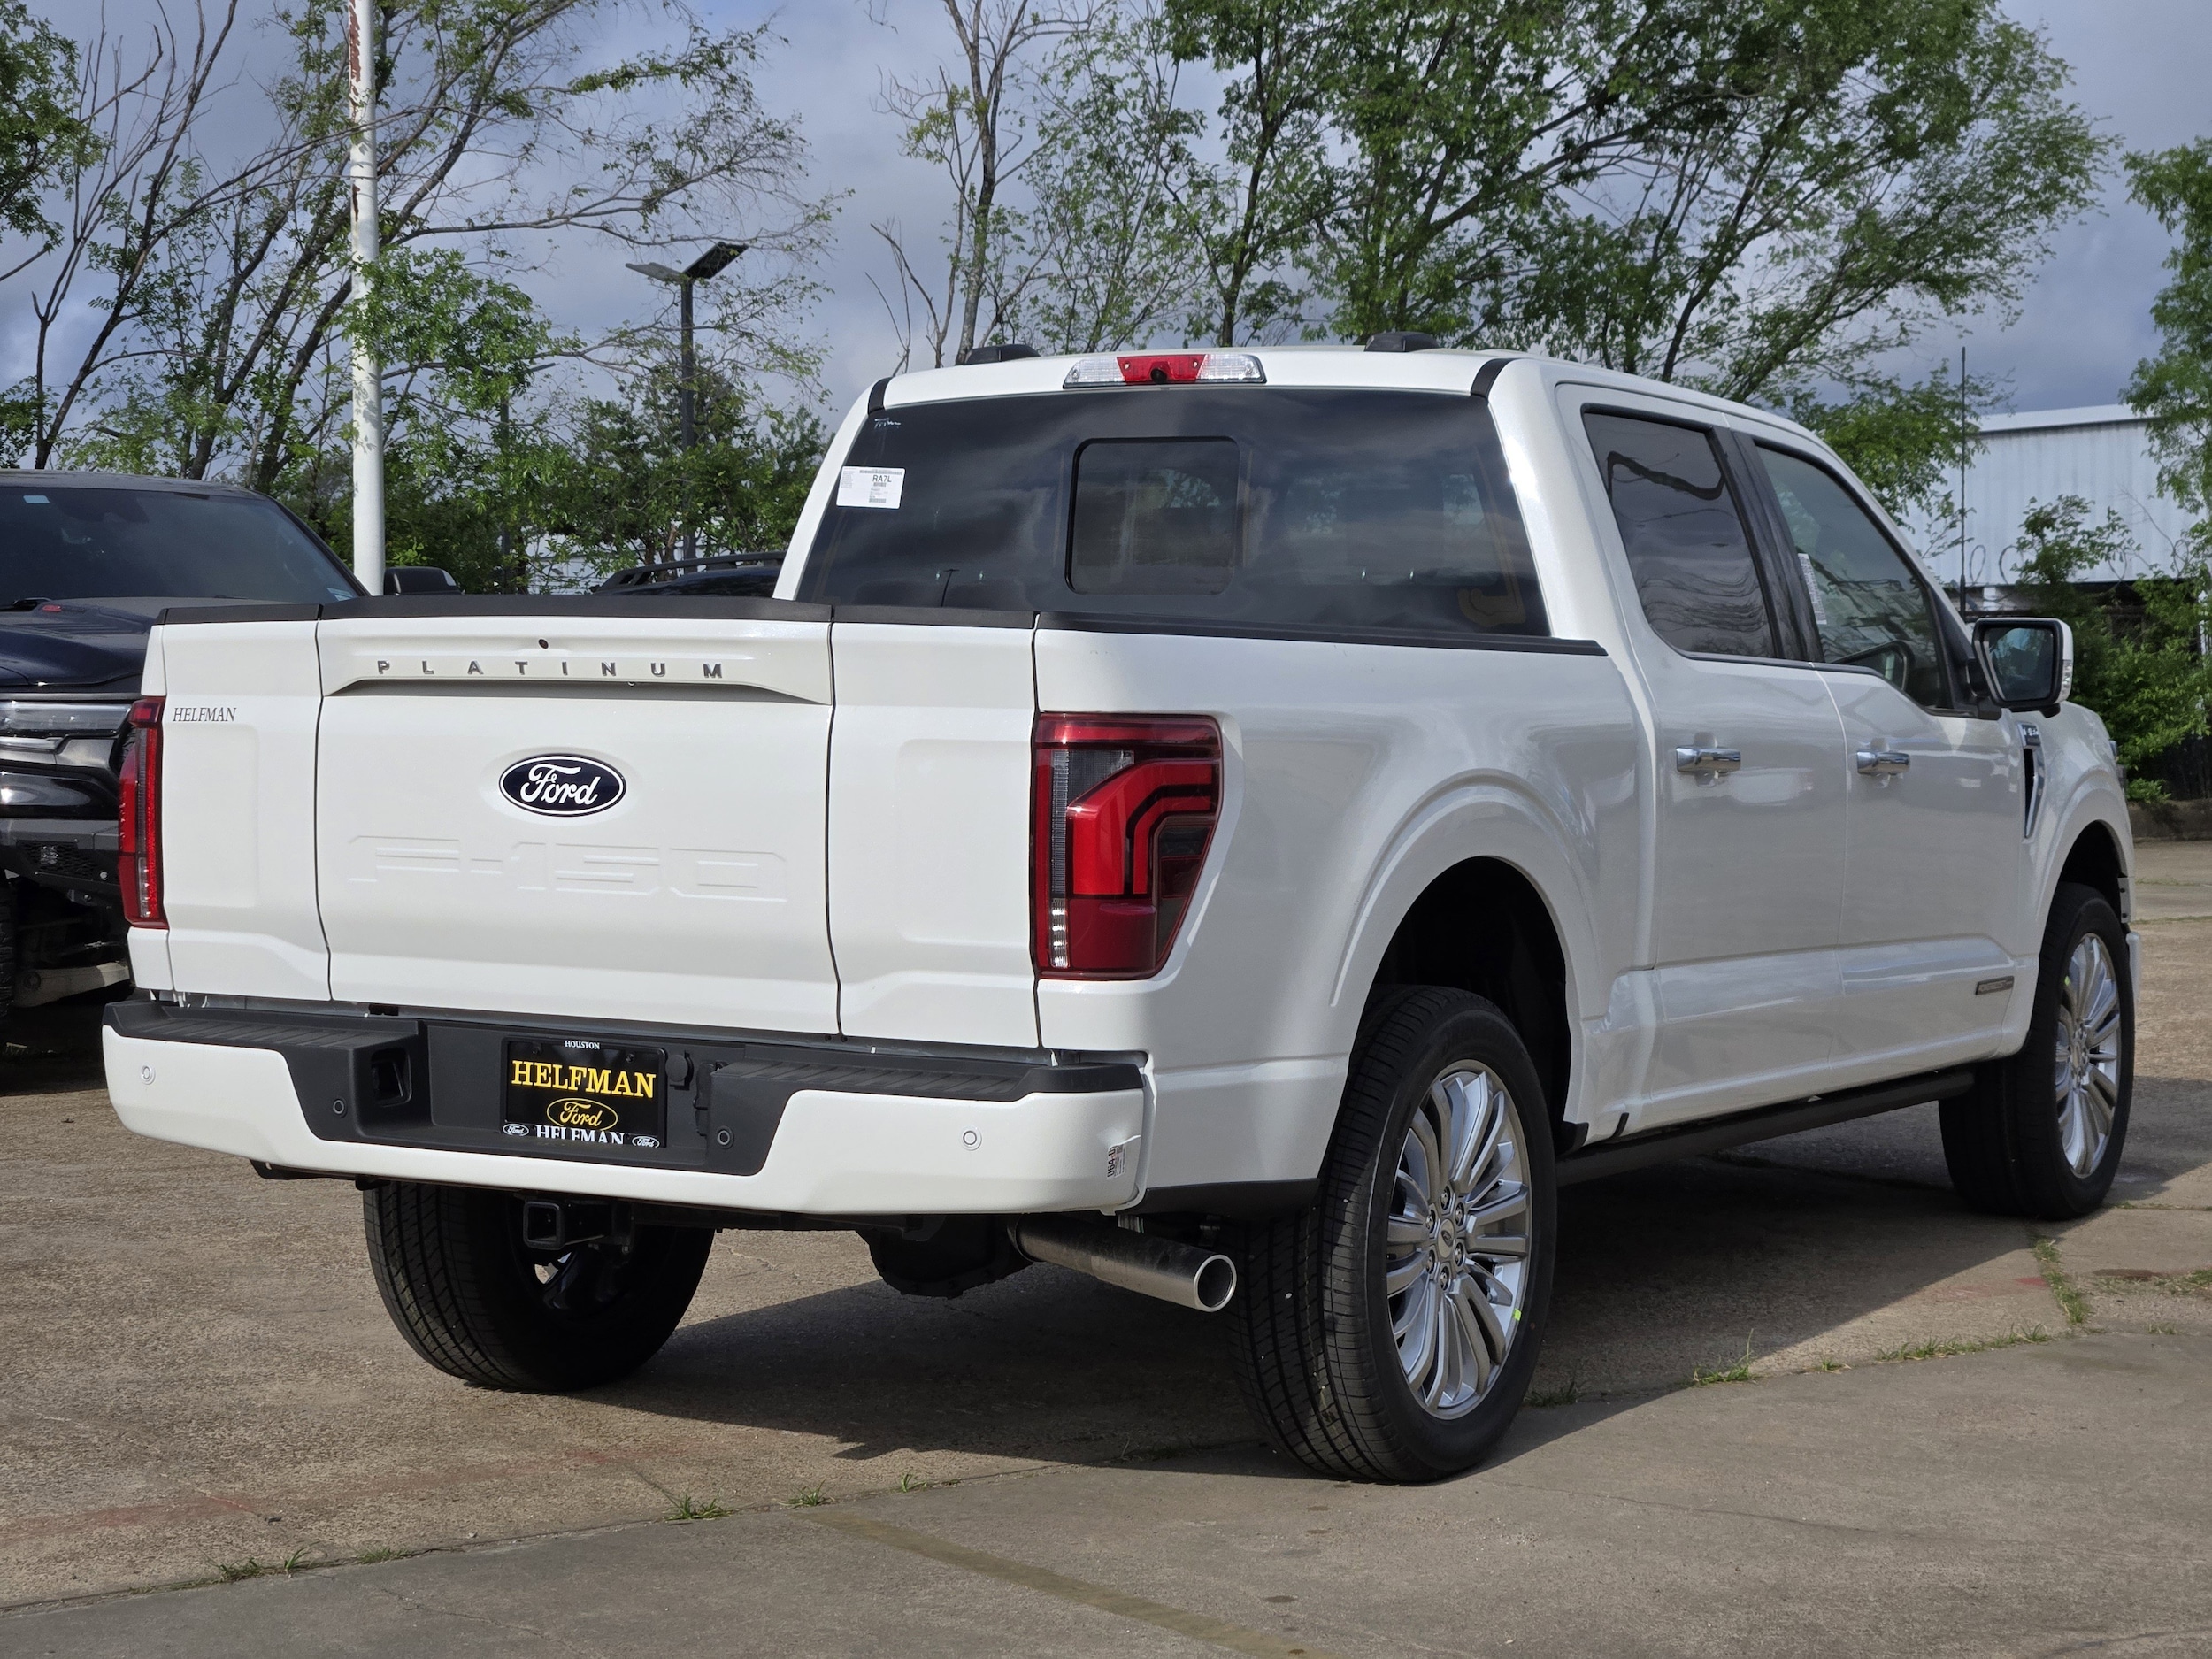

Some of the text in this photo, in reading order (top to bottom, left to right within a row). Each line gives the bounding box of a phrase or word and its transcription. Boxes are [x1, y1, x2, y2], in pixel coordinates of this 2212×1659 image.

[377, 660, 724, 679] PLATINUM
[173, 707, 237, 722] HELFMAN
[520, 764, 602, 805] Ford
[565, 1040, 601, 1050] HOUSTON
[511, 1060, 657, 1099] HELFMAN
[559, 1101, 603, 1127] Ford
[535, 1125, 625, 1145] HELFMAN
